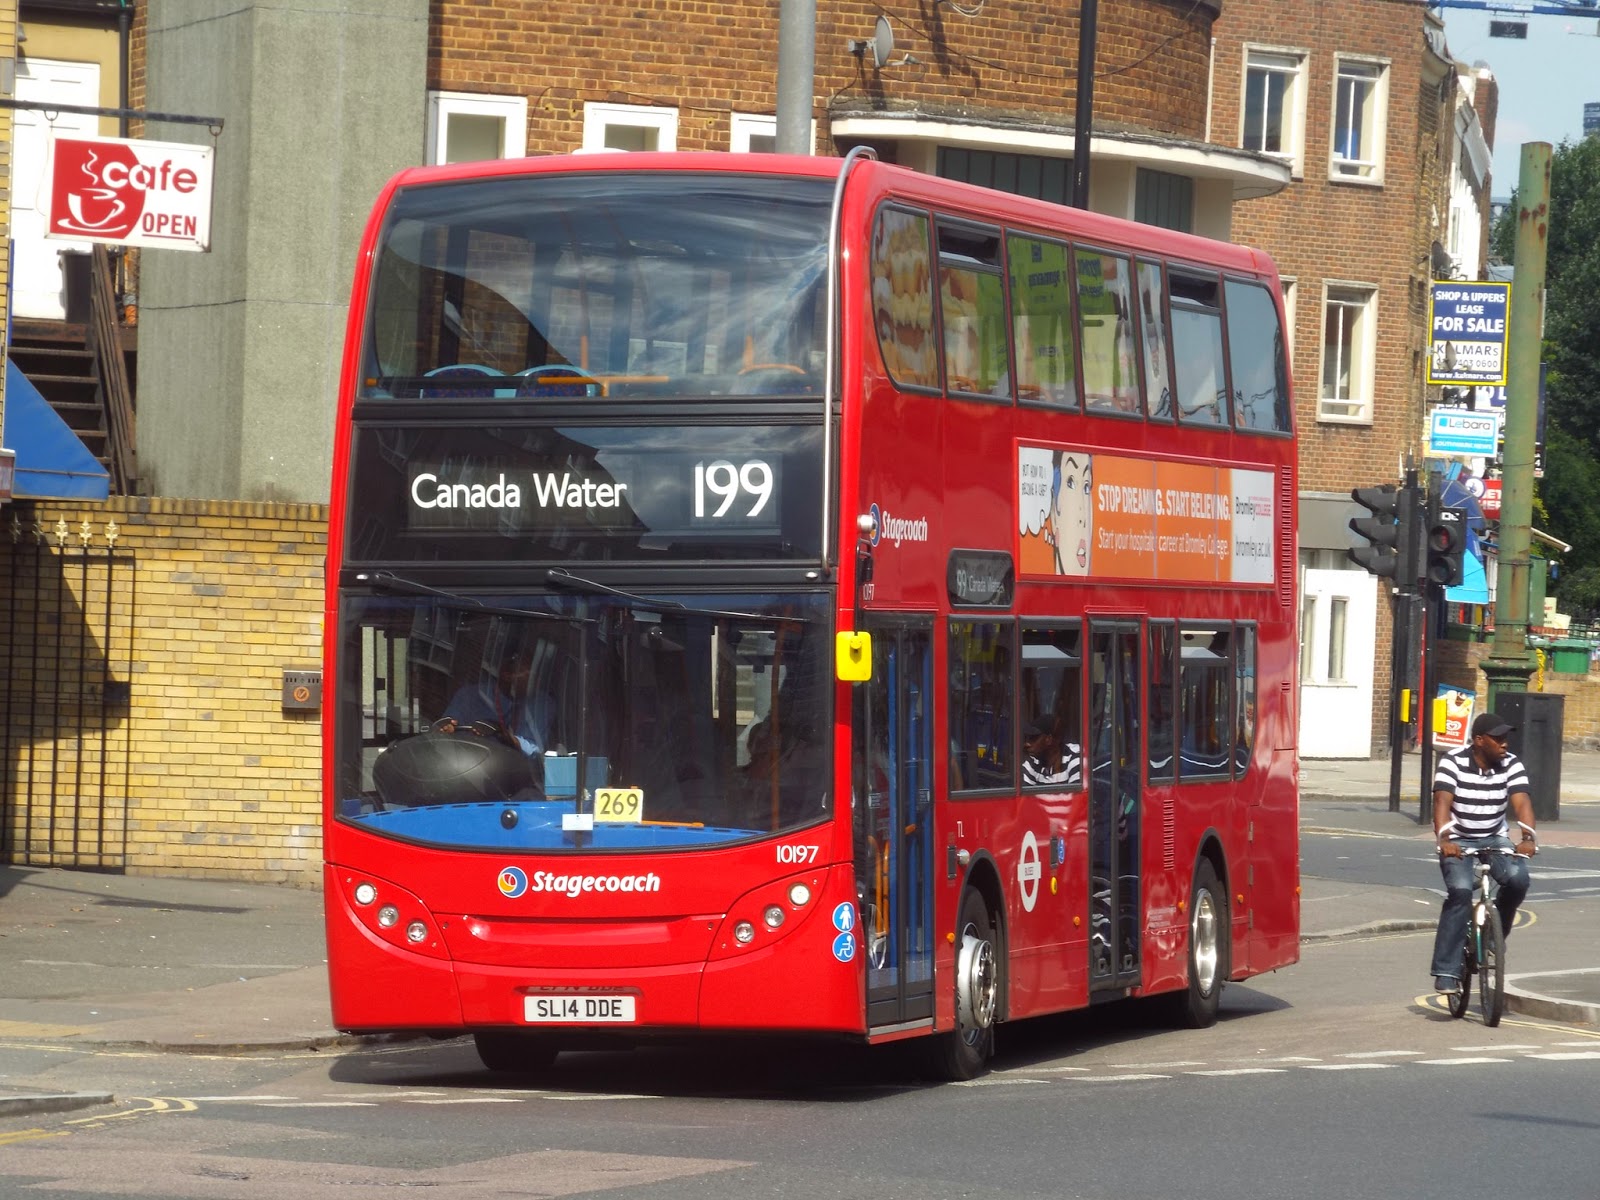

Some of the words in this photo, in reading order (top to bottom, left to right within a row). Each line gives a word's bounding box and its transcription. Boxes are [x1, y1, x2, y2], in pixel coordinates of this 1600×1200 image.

[102, 160, 198, 193] cafe
[142, 212, 197, 236] OPEN
[1435, 291, 1461, 301] SHOP
[1461, 292, 1470, 301] &
[1471, 292, 1506, 303] UPPERS
[1455, 304, 1484, 314] LEASE
[1434, 316, 1464, 331] FOR
[1466, 317, 1504, 333] SALE
[1449, 418, 1491, 430] Lebara
[411, 473, 521, 509] Canada
[532, 472, 628, 509] Water
[694, 459, 775, 518] 199
[1098, 483, 1121, 512] STOP
[1166, 489, 1189, 517] START
[881, 510, 928, 549] Stagecoach
[1098, 527, 1114, 549] Start
[1158, 535, 1178, 552] career
[599, 792, 639, 816] 269
[776, 844, 820, 864] 10197
[531, 870, 661, 898] Stagecoach
[536, 999, 580, 1018] SL14
[585, 999, 623, 1018] DDE
